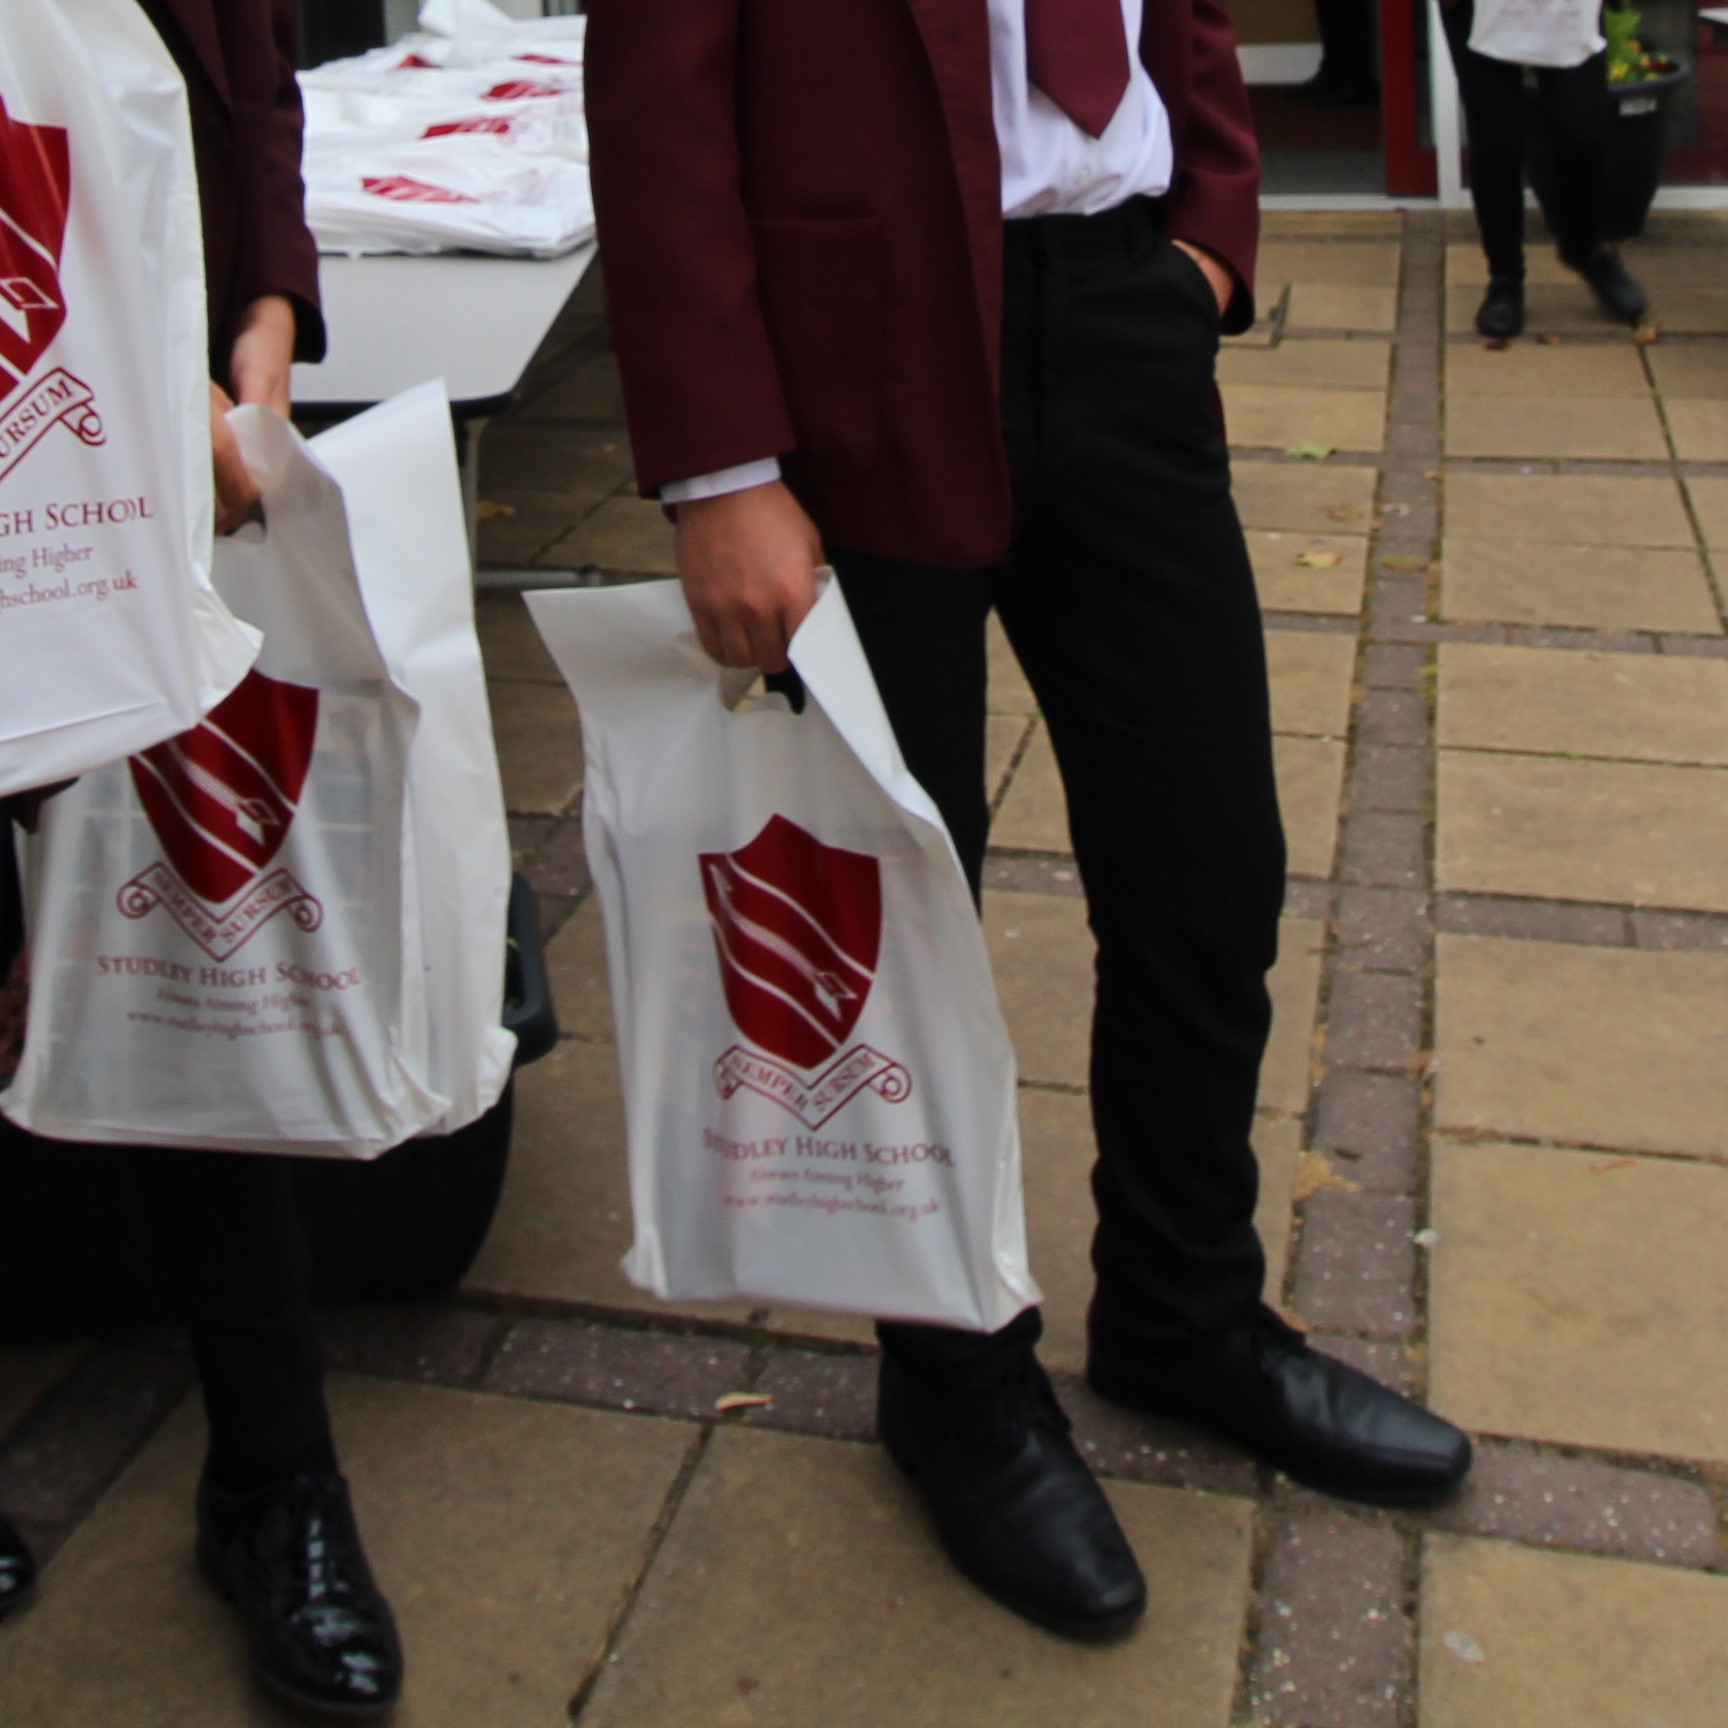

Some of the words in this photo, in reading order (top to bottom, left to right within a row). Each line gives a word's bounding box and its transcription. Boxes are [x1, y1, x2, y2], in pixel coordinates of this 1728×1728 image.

[32, 542, 94, 573] Higher
[199, 966, 267, 987] HIGH
[796, 1135, 857, 1161] HIGH
[863, 1141, 956, 1168] SCHOOL
